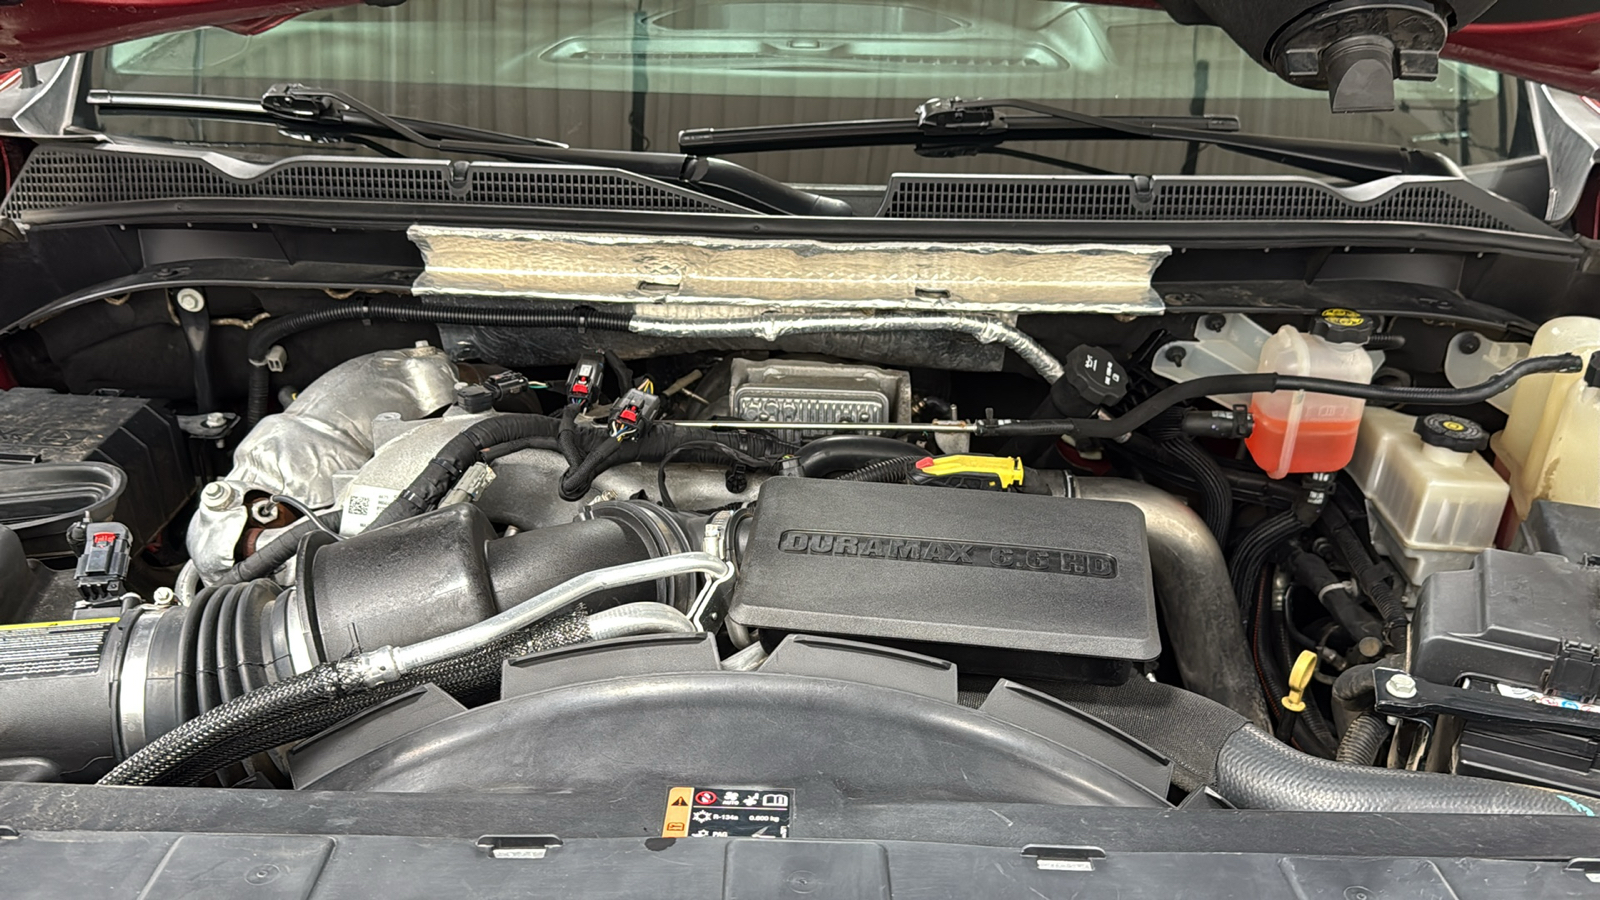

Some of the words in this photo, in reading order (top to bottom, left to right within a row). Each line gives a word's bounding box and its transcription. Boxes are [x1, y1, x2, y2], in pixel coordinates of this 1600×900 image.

[783, 532, 973, 564] DURAMAX
[989, 547, 1050, 571] 6.6
[1060, 552, 1114, 577] HD
